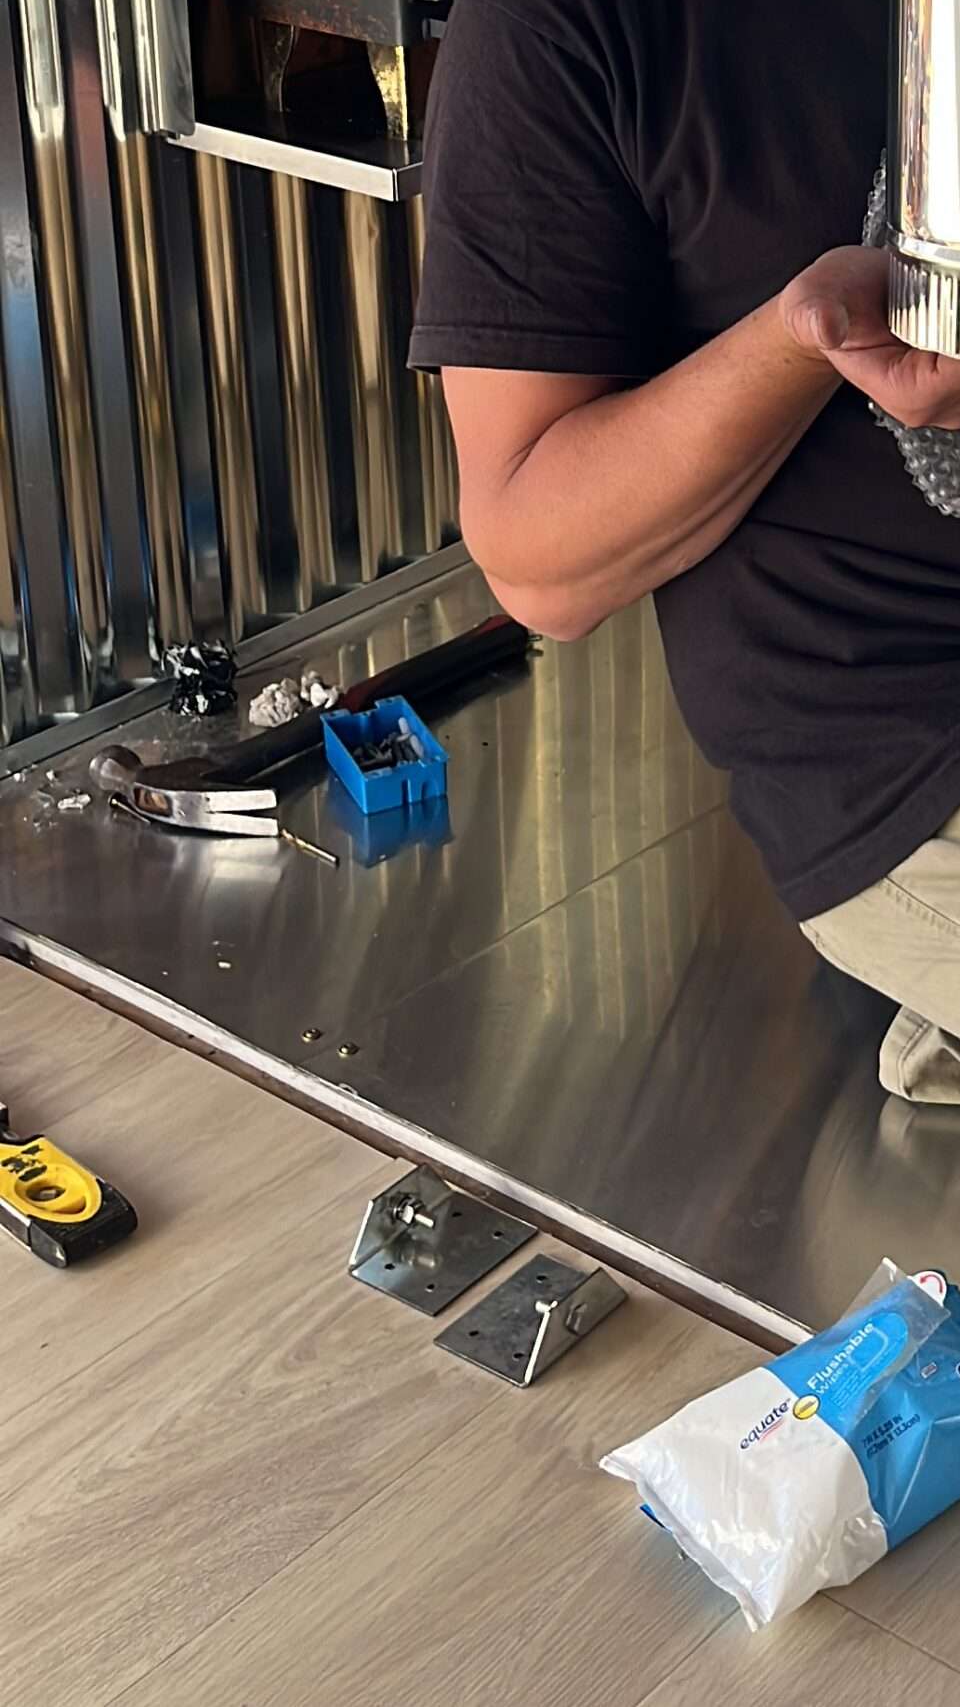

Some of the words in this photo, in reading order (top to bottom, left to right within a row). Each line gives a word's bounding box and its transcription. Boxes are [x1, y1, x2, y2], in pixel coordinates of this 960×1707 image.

[806, 1322, 874, 1391] Flushable
[816, 1363, 849, 1395] Wipes
[739, 1400, 790, 1451] equate
